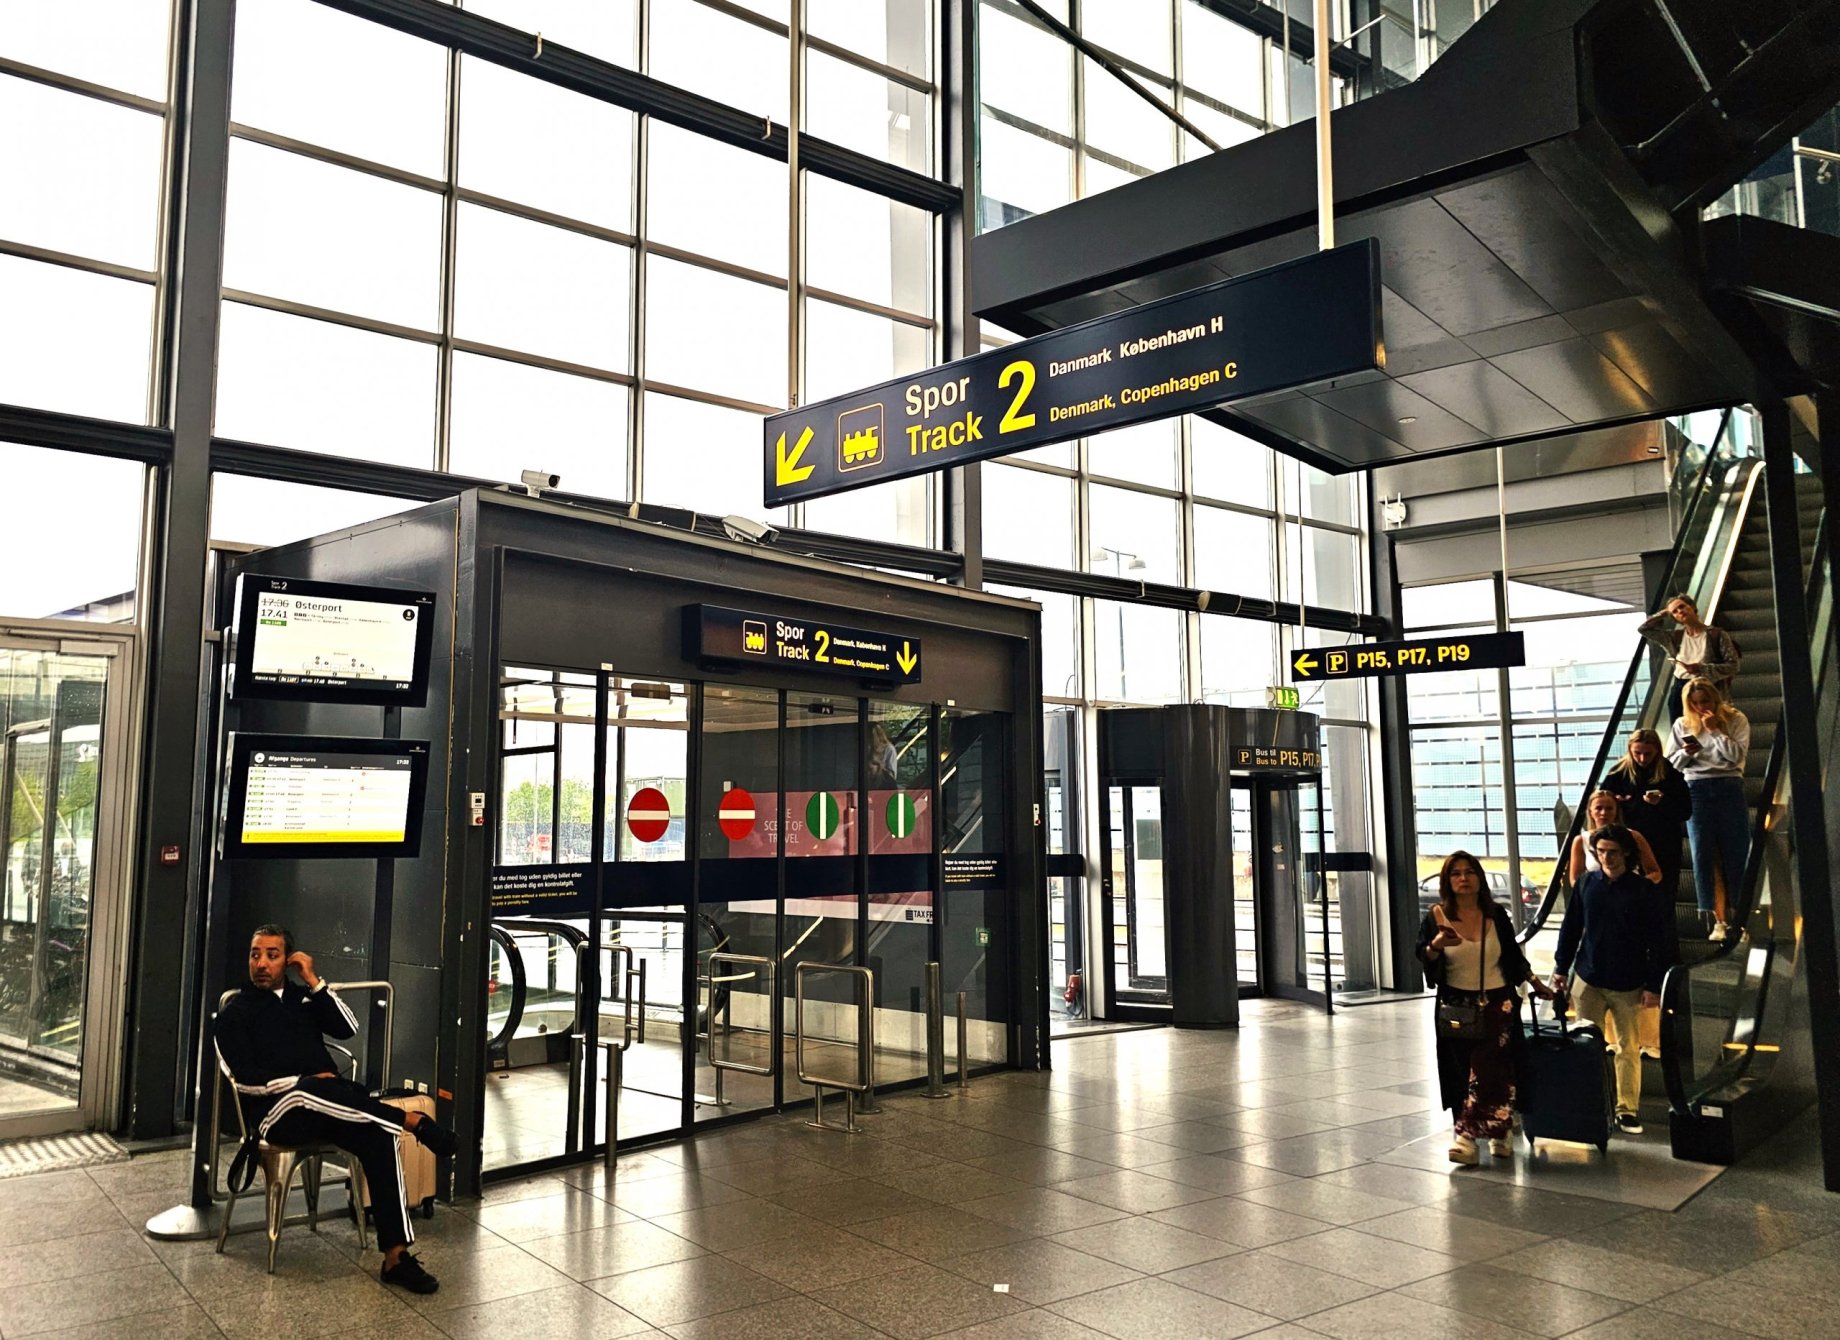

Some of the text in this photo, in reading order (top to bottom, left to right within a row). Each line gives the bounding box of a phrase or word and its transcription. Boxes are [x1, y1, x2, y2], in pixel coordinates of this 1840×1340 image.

[1050, 316, 1223, 377] Danmark København H
[905, 376, 970, 419] Spor
[998, 360, 1036, 434] 2
[1050, 362, 1237, 422] Denmark, Copenhagen C
[906, 411, 984, 456] Track
[281, 581, 288, 590] 2
[295, 600, 342, 613] Østerport
[776, 621, 805, 641] Spor
[776, 641, 810, 660] Track
[814, 630, 830, 663] 2
[856, 660, 885, 671] Copenhagen
[885, 663, 890, 671] C
[1357, 651, 1392, 669] P15,
[1397, 647, 1431, 665] P17,
[1437, 644, 1470, 662] P19
[1255, 748, 1268, 756] Bus
[1256, 757, 1268, 765] Bus
[1280, 750, 1301, 768] P15,
[764, 821, 803, 831] SCET OF
[768, 833, 799, 844] TRVEL
[913, 910, 925, 918] TAX
